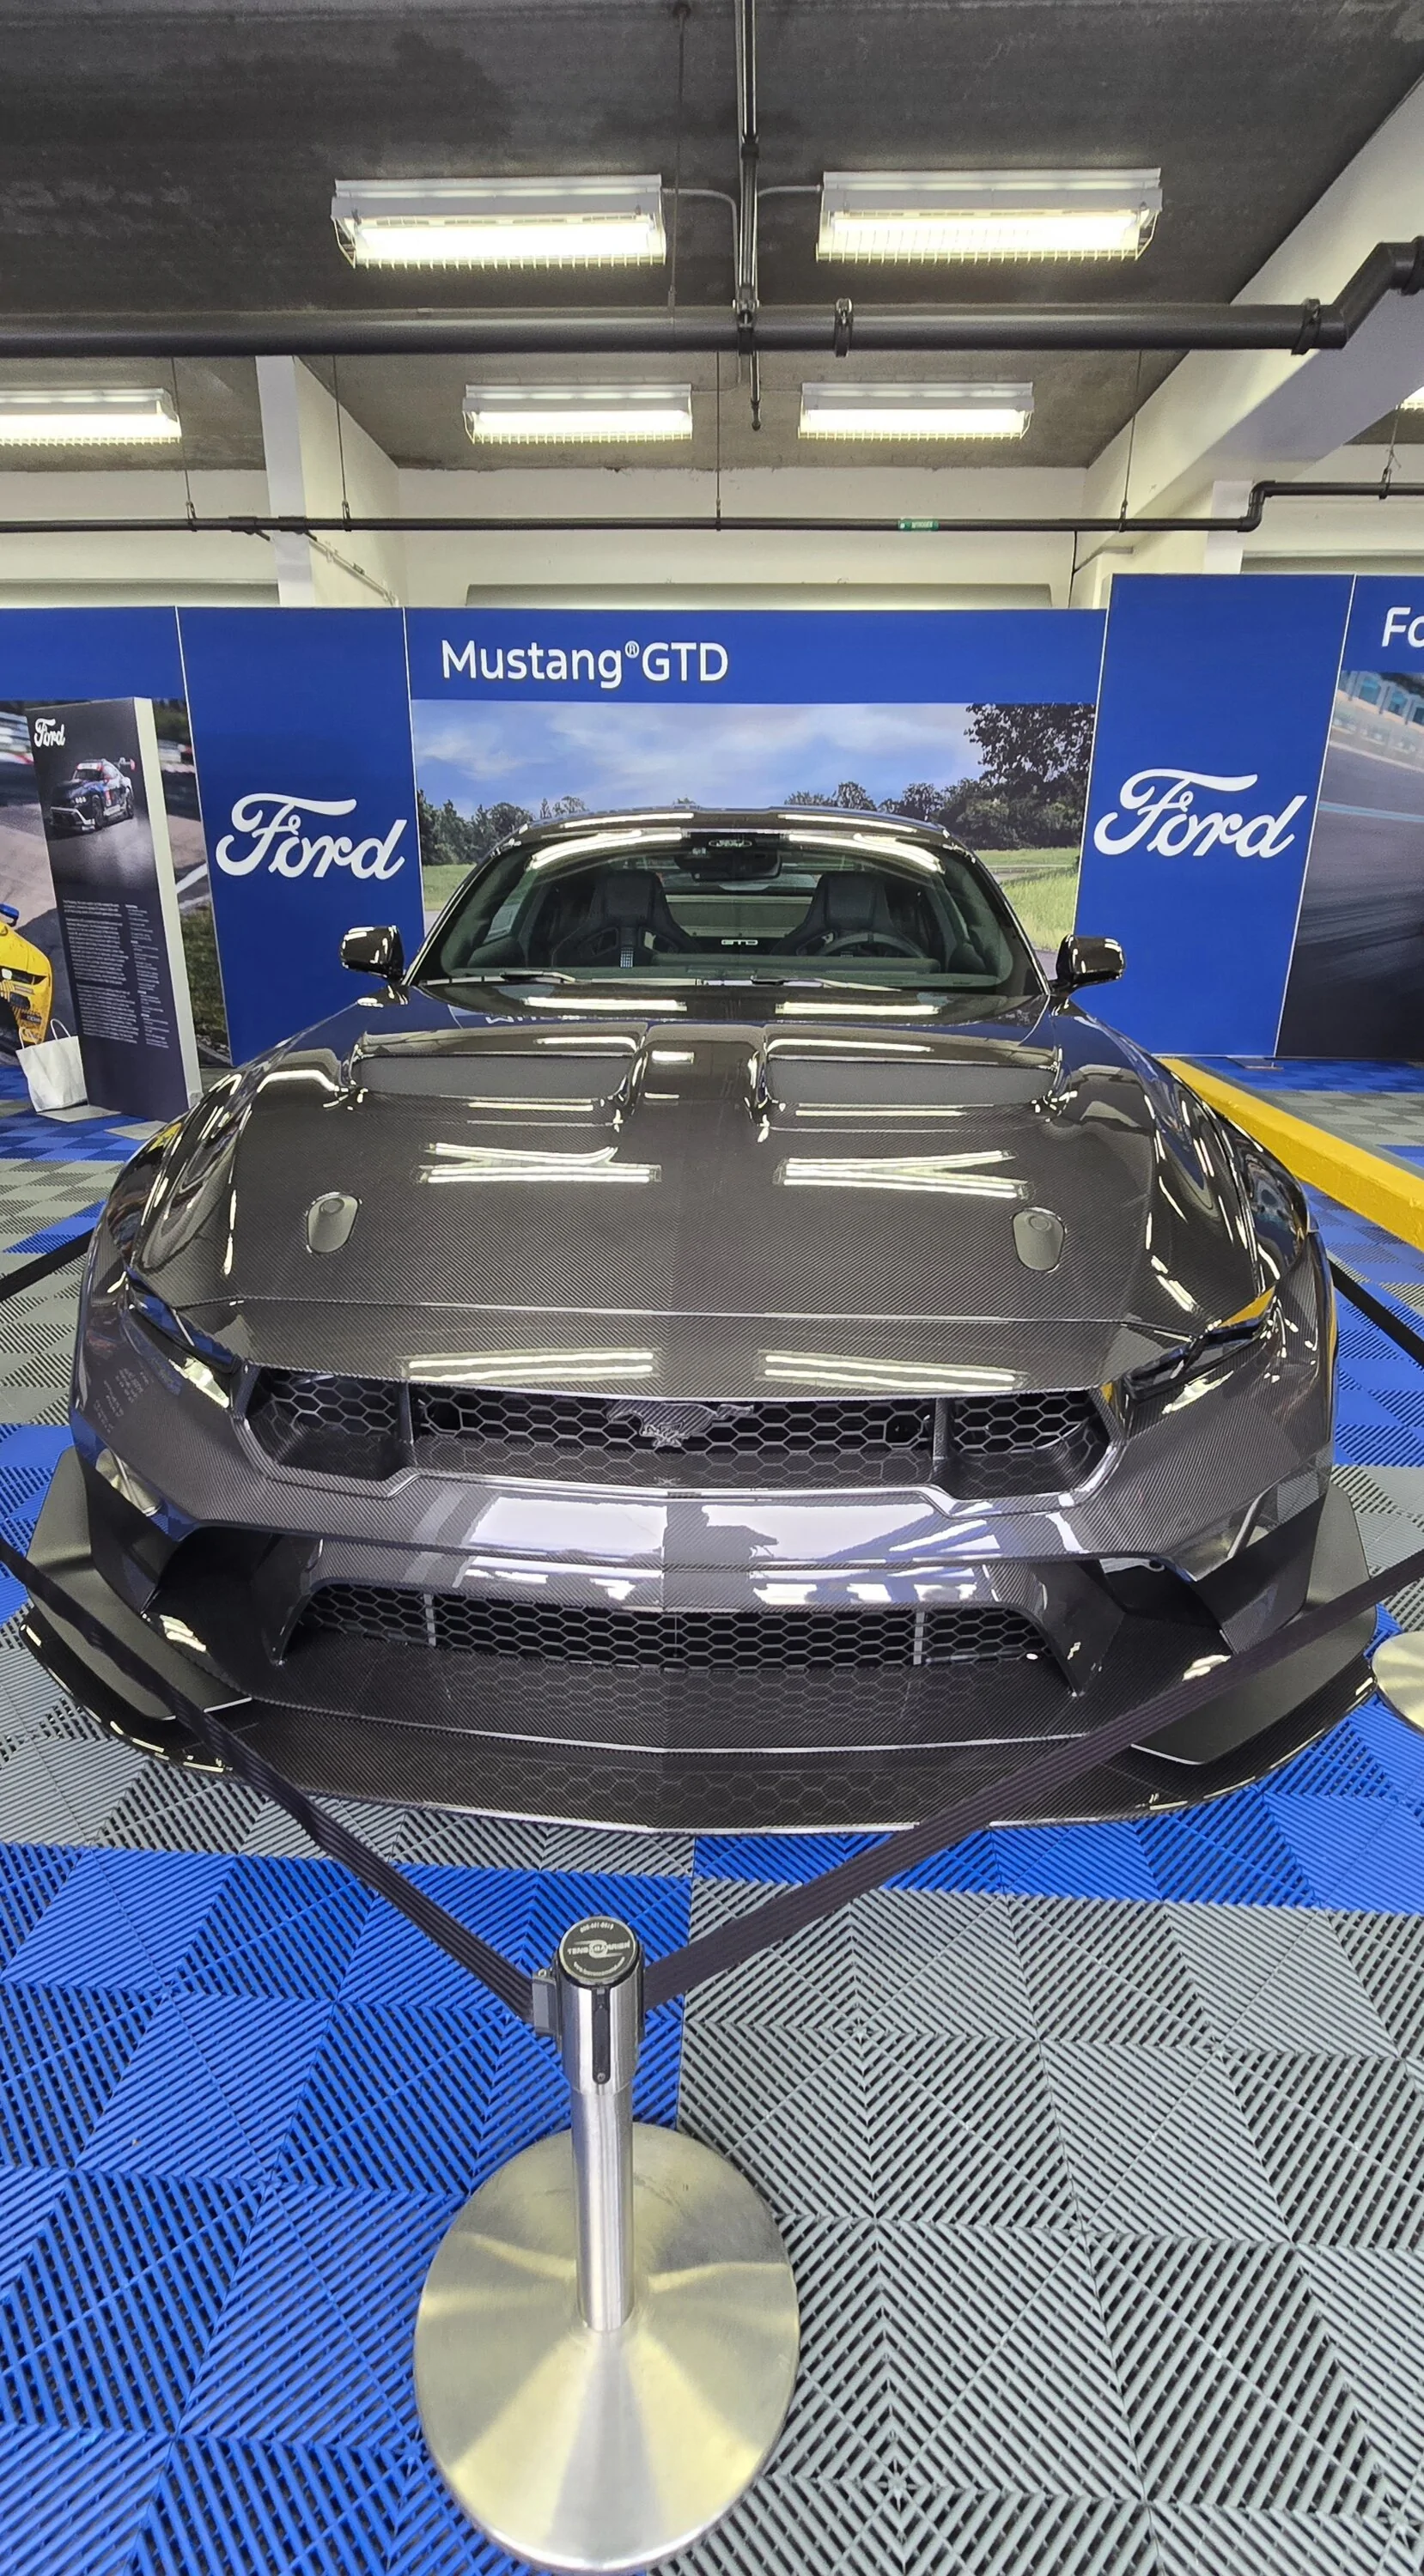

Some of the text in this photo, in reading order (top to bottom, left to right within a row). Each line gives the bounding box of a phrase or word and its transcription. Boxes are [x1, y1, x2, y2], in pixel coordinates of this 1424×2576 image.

[642, 641, 728, 682] GTD
[33, 718, 66, 747] Ford
[216, 793, 408, 881] Ford
[1093, 768, 1308, 859] Ford
